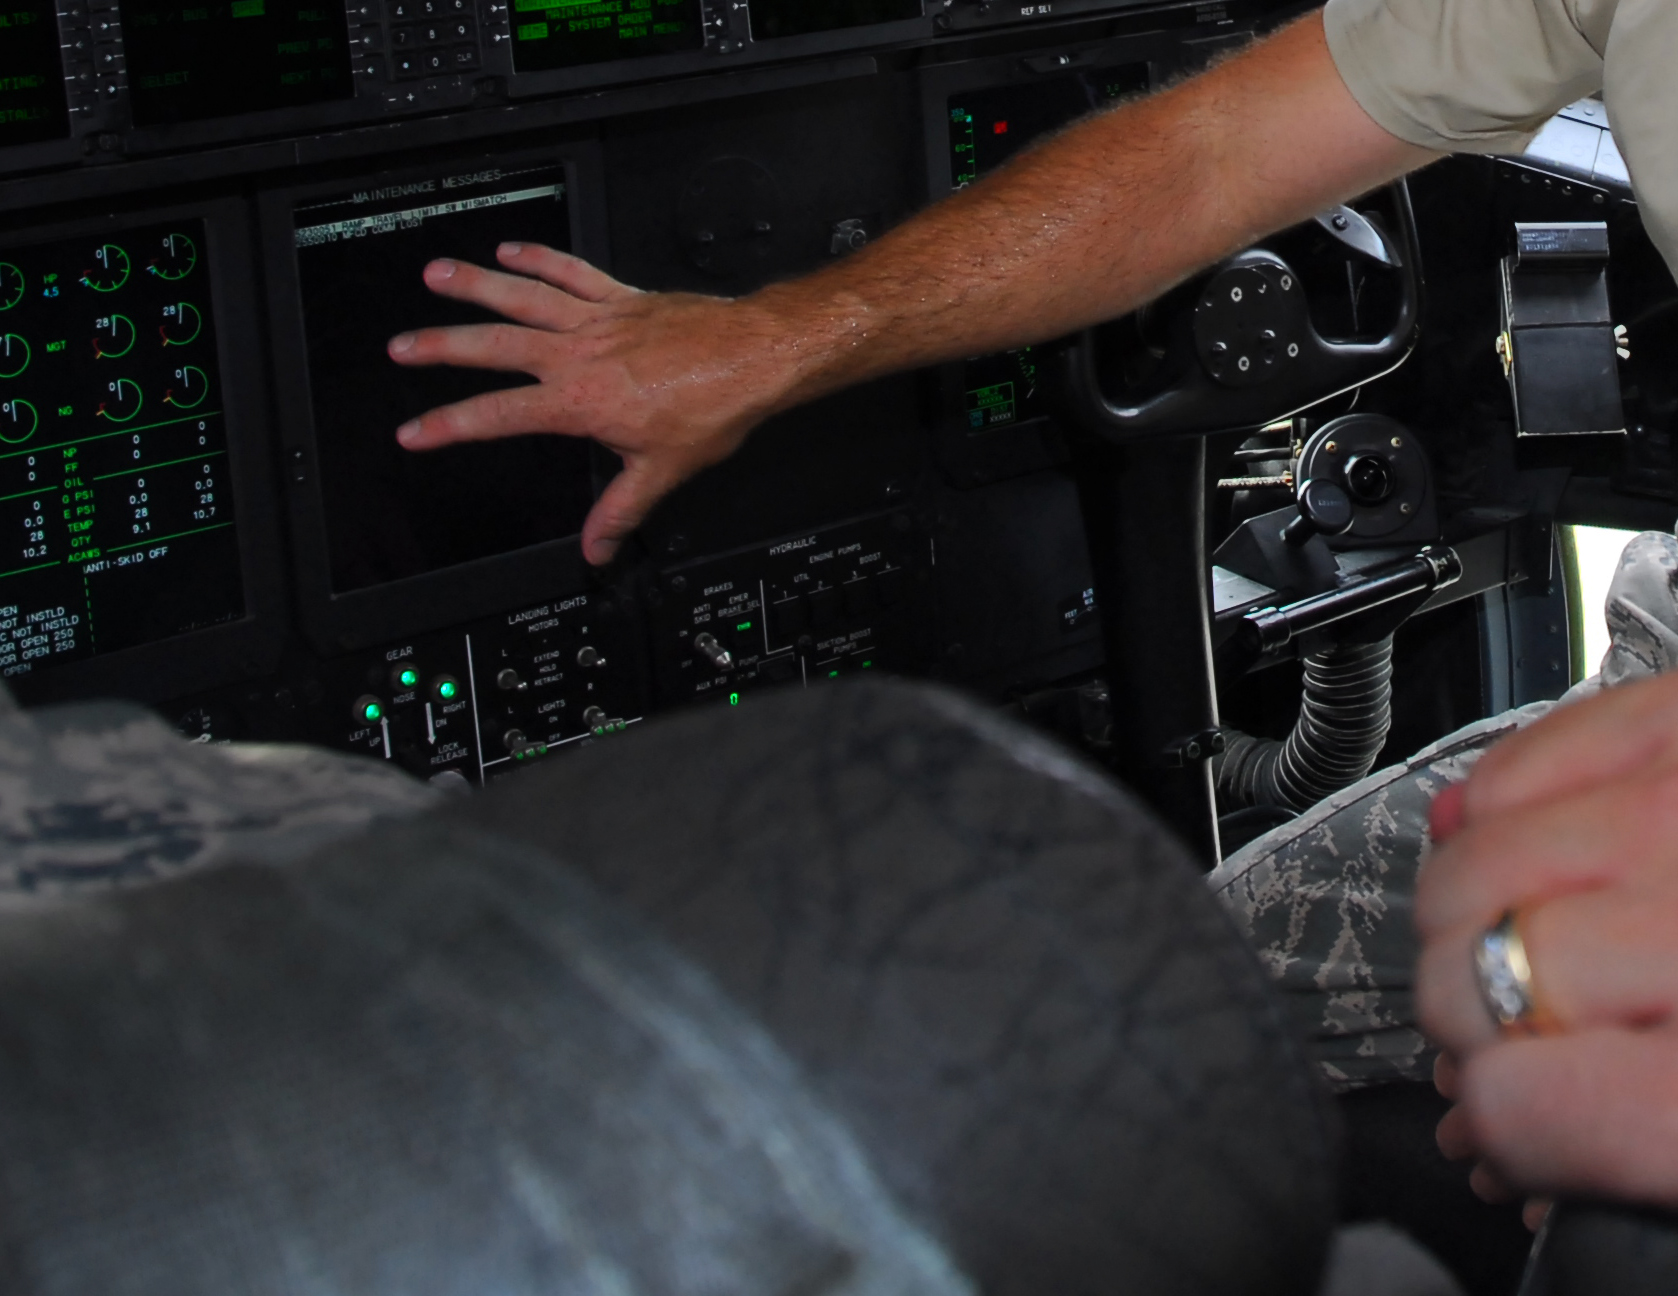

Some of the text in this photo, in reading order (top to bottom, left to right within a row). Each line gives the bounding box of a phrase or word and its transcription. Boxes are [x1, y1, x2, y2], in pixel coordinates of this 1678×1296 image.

[546, 0, 623, 20] MAINTENANCE
[568, 16, 612, 32] SYSTEM
[457, 52, 472, 62] CLR
[140, 71, 190, 89] SELECT
[342, 194, 508, 229] RAMP TRAVEL LIMIT SW MISMATCH
[371, 224, 396, 235] COMM
[400, 218, 423, 230] LOST
[43, 273, 58, 284] HP
[42, 286, 60, 298] 4.5
[162, 305, 176, 316] 28
[95, 317, 110, 329] 28
[46, 339, 67, 353] MGT
[58, 405, 73, 416] NG
[27, 421, 206, 466] 0 NP 0 0
[28, 435, 206, 481] 0 FF 0 0
[32, 464, 211, 511] 0 G PSI 0 0
[64, 477, 84, 489] OIL
[24, 478, 213, 528] 0.0 E PSI 0.0 0.0
[30, 492, 214, 542] 28 TEMP 28 28
[22, 506, 216, 558] 10.2 9.1 10.7
[769, 535, 817, 556] HYDRAULIC
[67, 547, 102, 563] ACAWS
[86, 546, 168, 574] ANTI-SKID OFF
[808, 543, 862, 564] ENGINE PUMPS
[859, 552, 882, 565] BOOST
[793, 573, 810, 583] UTIL
[703, 581, 734, 596] BRAKES
[728, 592, 749, 605] EMER
[26, 606, 65, 623] INSTLD
[508, 595, 587, 625] LANDING LIGHTS
[693, 603, 711, 614] ANTI
[718, 599, 761, 618] BRAKE SEL
[528, 618, 560, 633] MOTORS
[694, 613, 711, 624] SKID
[12, 625, 33, 639] NOT
[41, 614, 79, 632] INSTLD
[20, 627, 74, 648] OPEN 250
[816, 628, 872, 651] SUCTION BOOST
[22, 639, 75, 660] OPEN 250
[386, 645, 414, 661] GEAR
[833, 642, 857, 655] PUMPS
[533, 650, 560, 664] EXTEND
[4, 663, 32, 677] OPEN
[539, 663, 557, 674] HOLD
[534, 672, 564, 686] RETRACT
[393, 691, 416, 704] NOSE
[442, 700, 467, 714] RIGHT
[538, 699, 566, 714] LIGHTS
[435, 718, 447, 728] DN
[349, 728, 371, 742] LEFT
[368, 737, 381, 747] UP
[438, 741, 459, 754] LOCK
[430, 747, 468, 765] RELEASE
